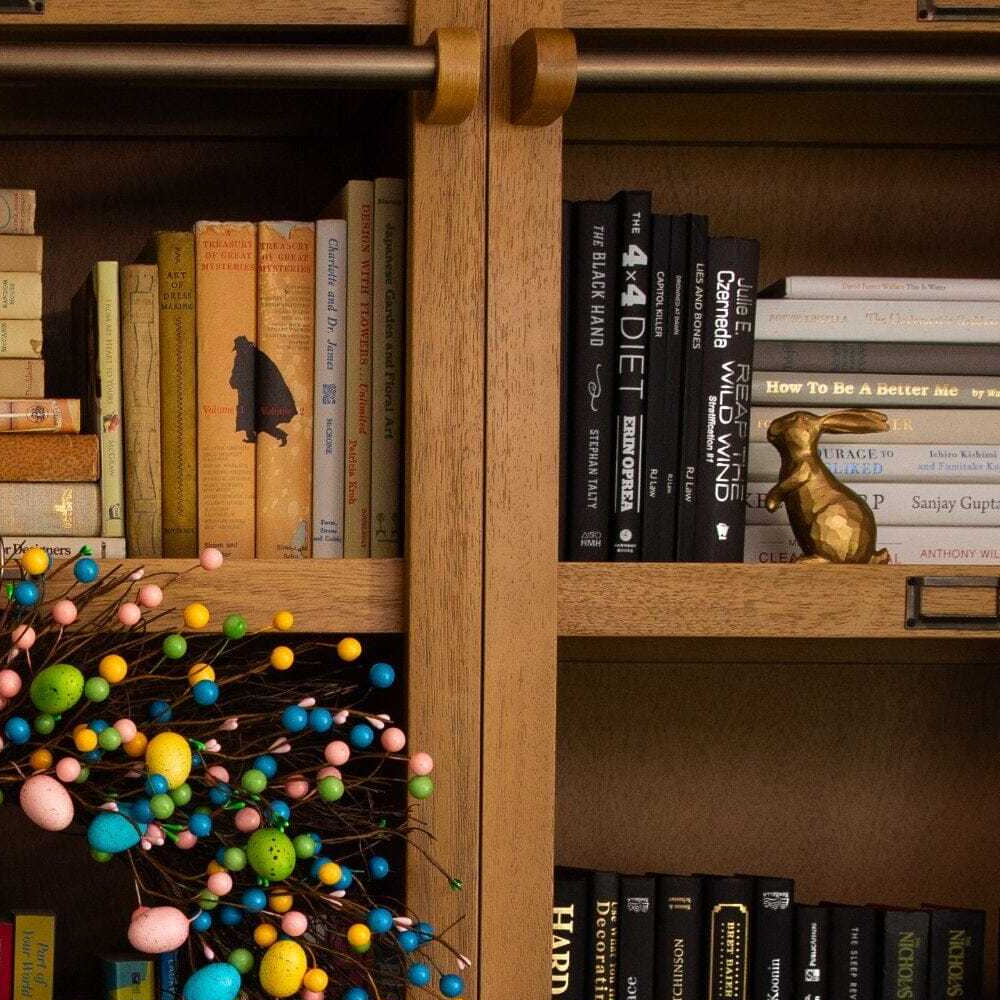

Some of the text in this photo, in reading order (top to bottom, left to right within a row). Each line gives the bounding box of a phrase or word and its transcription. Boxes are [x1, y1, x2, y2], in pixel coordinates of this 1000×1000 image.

[327, 238, 339, 371] Charlotte and Dr. James
[590, 225, 606, 347] THE BLACK HAND
[654, 271, 665, 338] CAPITOL KILLER
[692, 262, 705, 350] LIES AND BONES
[713, 270, 736, 349] Czerneda
[735, 277, 753, 336] Julie E.
[383, 222, 396, 441] Japanese Garden and Floral Art
[587, 429, 599, 509] STEPHAN TALTY
[620, 415, 637, 513] ERIN OPREA
[714, 360, 735, 502] WILD WIND
[648, 468, 658, 499] RJ Law
[684, 466, 695, 503] RJ Law
[724, 922, 735, 998] BRET BAIER
[849, 927, 859, 948] THE
[849, 950, 859, 979] SLEEP
